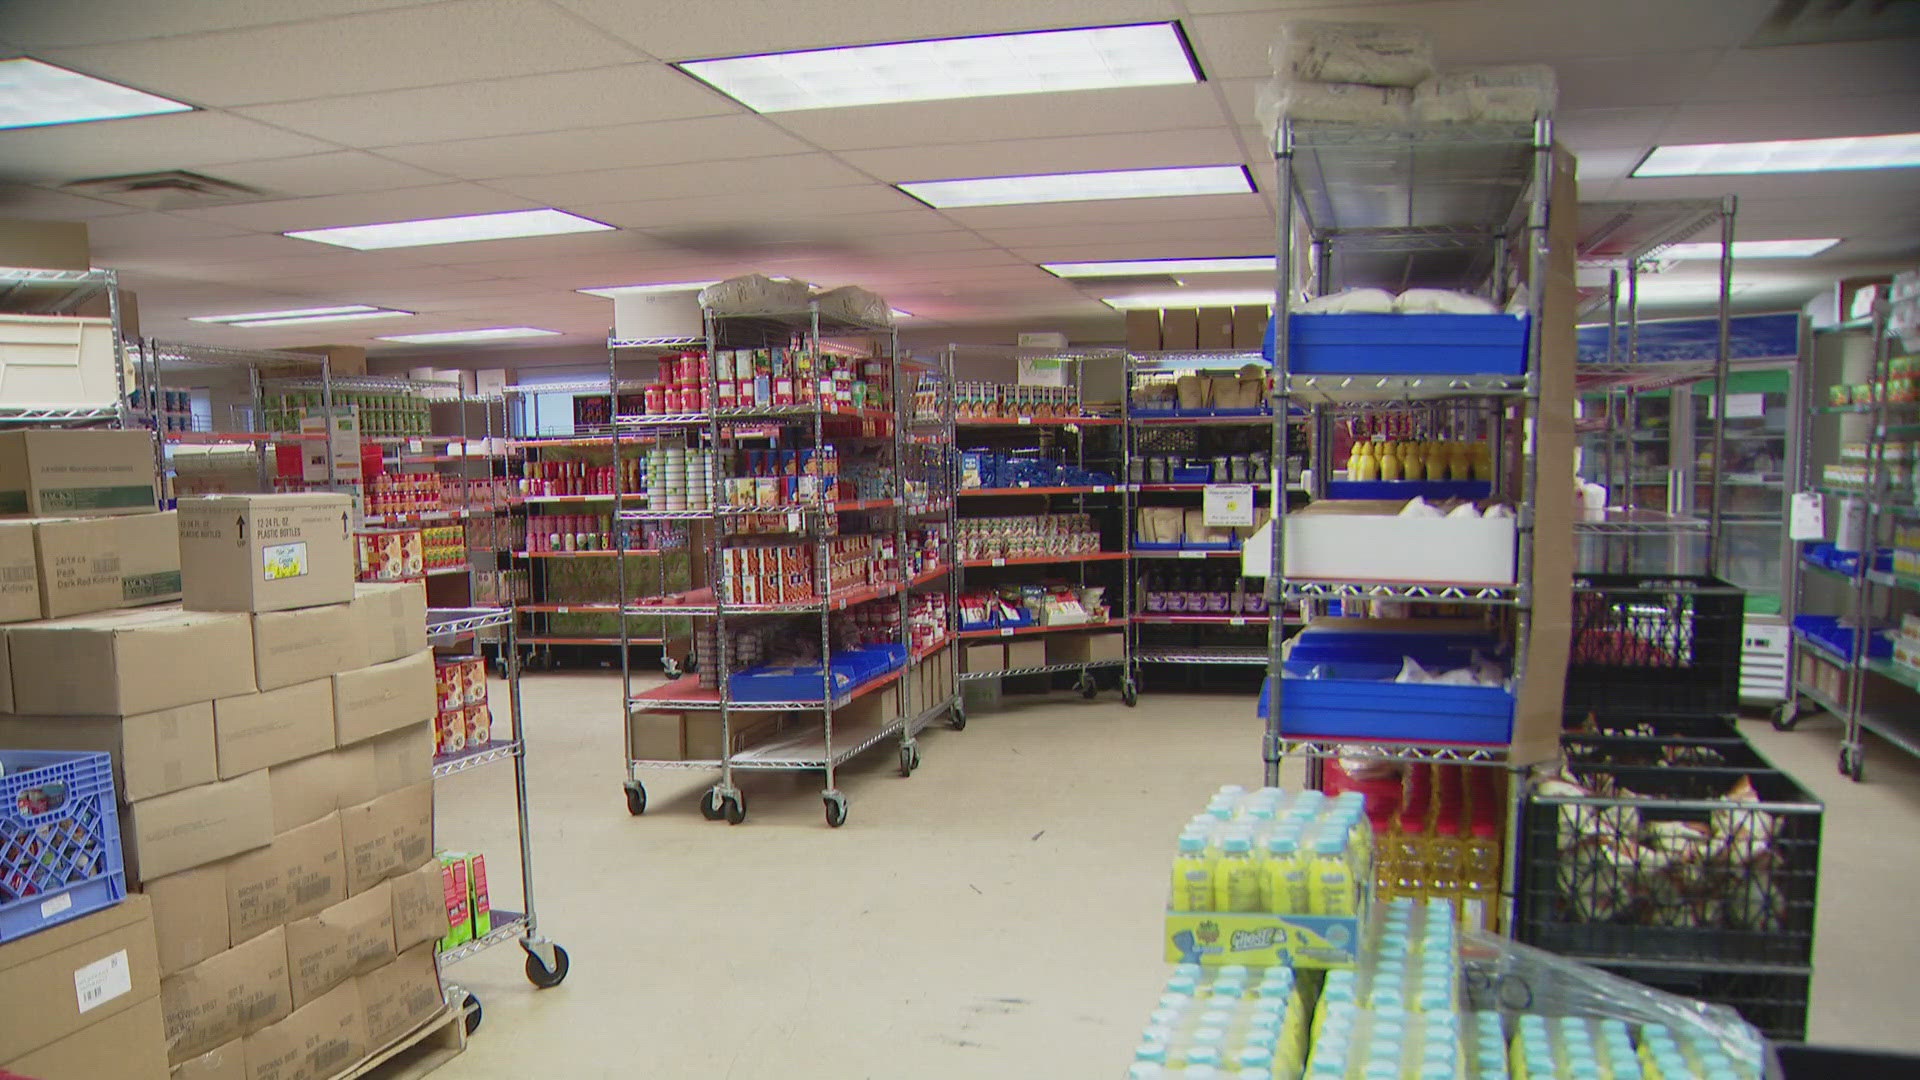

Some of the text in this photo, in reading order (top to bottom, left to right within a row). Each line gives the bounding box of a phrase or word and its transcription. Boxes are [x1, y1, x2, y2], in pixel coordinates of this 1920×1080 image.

[257, 527, 301, 540] PLASTIC BOTTLES
[57, 578, 76, 589] Dark
[77, 577, 91, 588] Red
